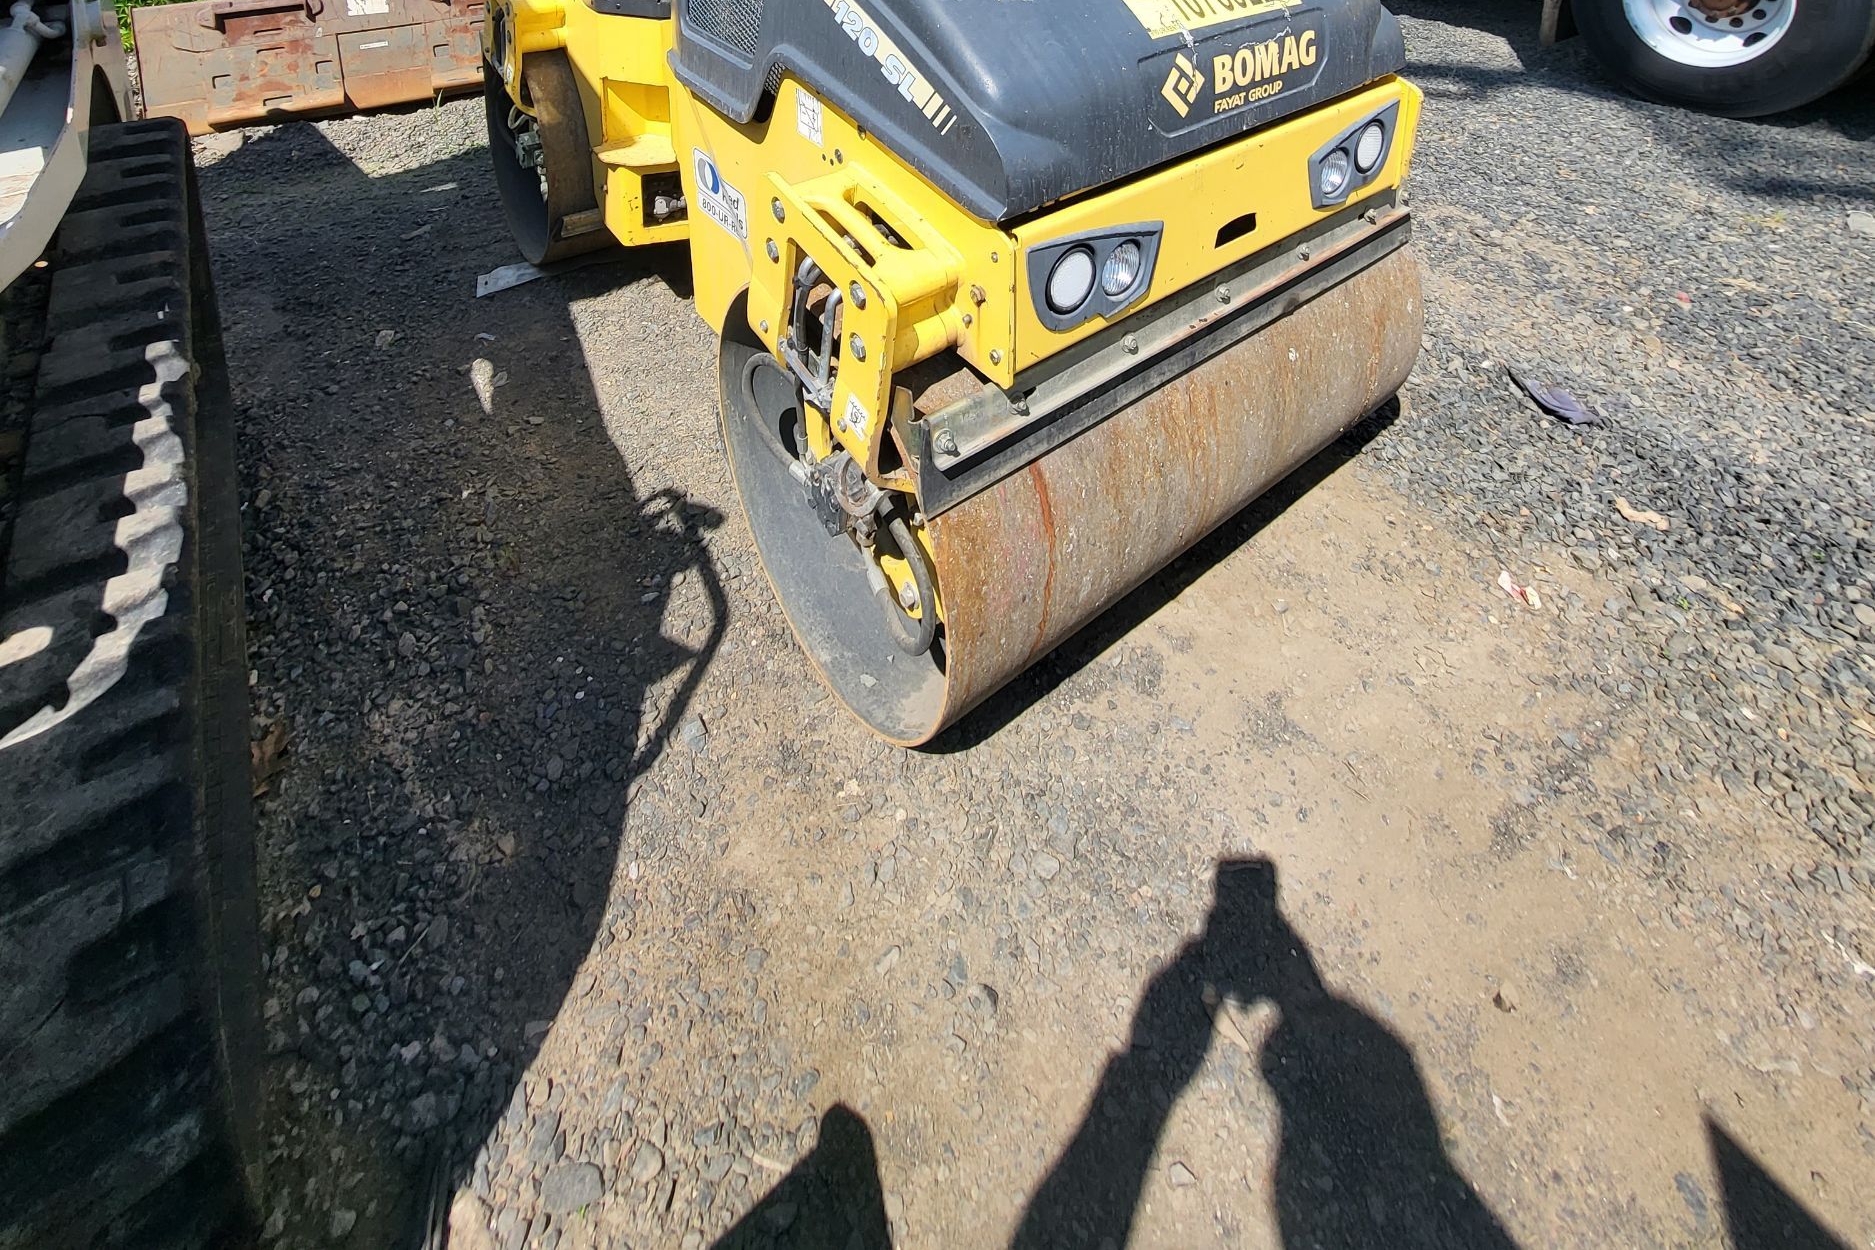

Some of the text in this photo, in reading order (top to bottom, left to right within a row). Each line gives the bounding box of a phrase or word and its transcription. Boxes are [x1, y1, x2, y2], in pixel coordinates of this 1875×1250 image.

[1213, 30, 1317, 94] BOMAG
[1214, 80, 1284, 114] FAYAT GROUP
